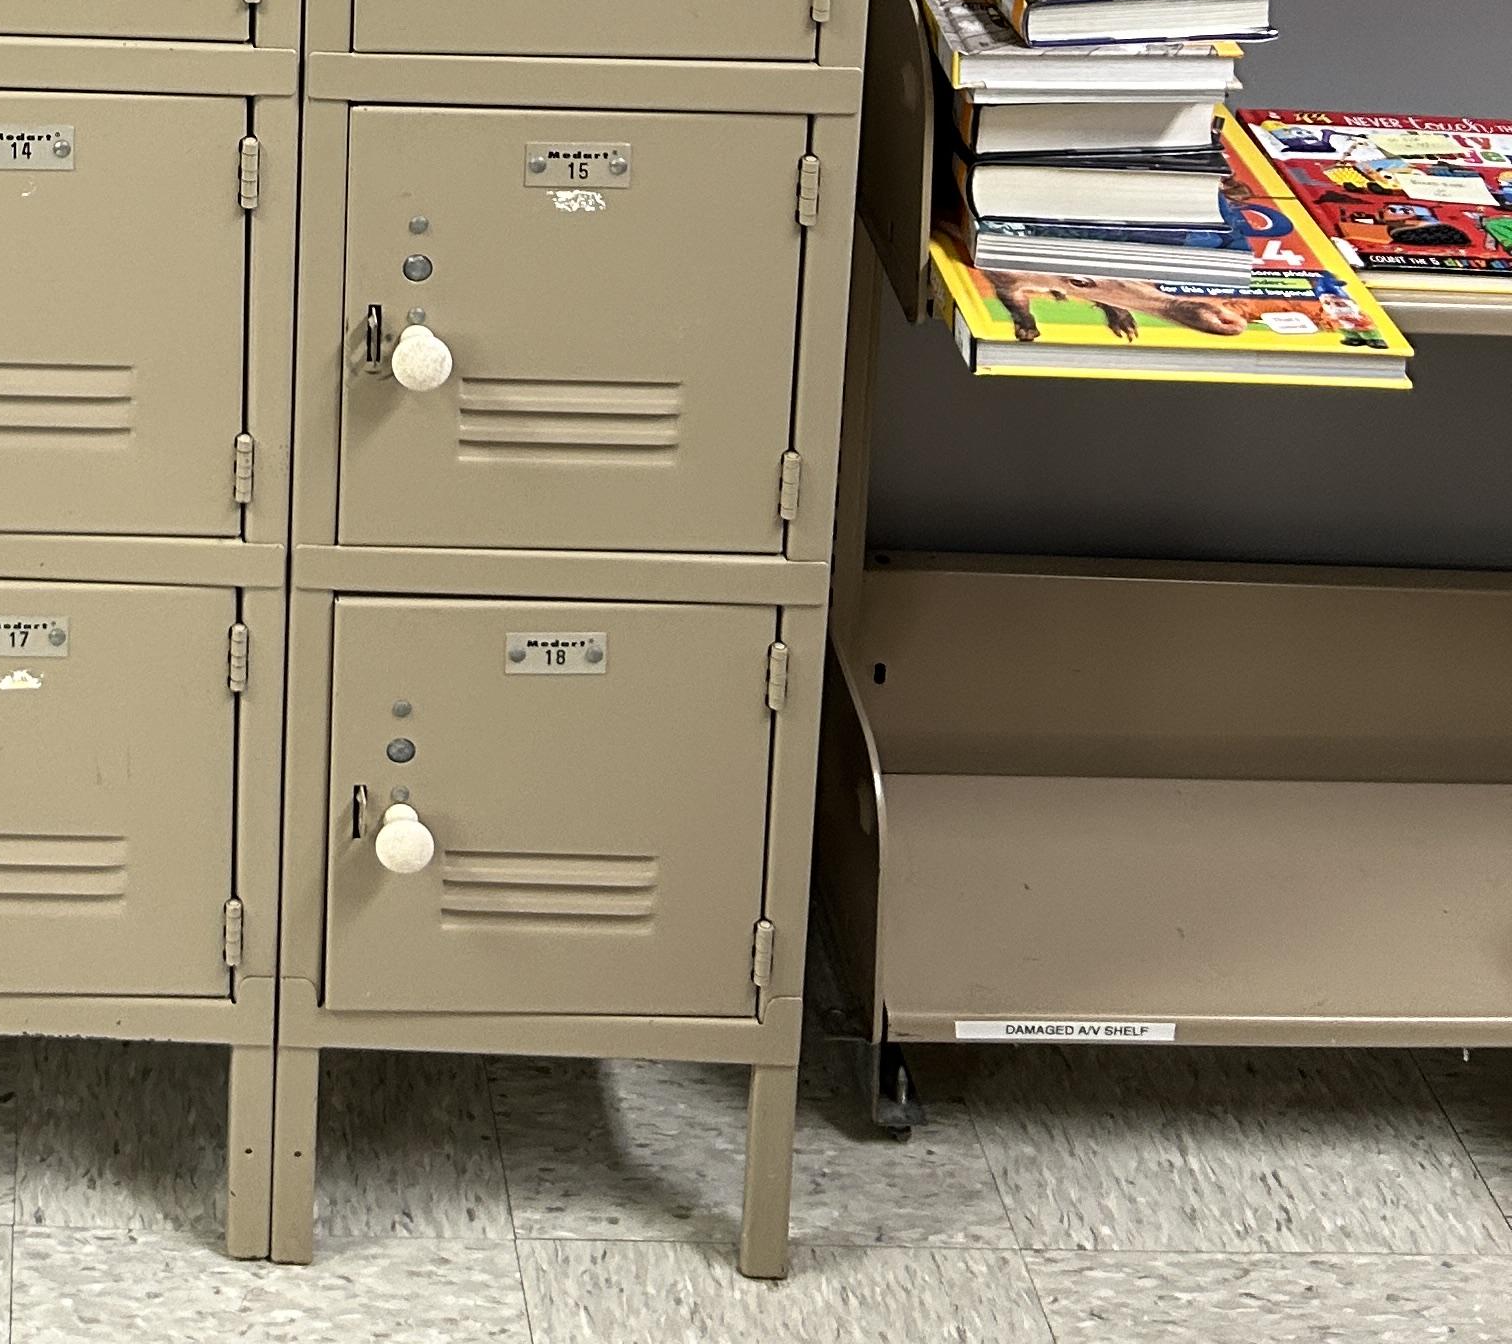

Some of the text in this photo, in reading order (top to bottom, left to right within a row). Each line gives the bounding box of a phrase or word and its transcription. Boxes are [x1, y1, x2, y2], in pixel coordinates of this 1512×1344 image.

[1343, 115, 1403, 128] NEVER
[1402, 116, 1487, 133] touch
[11, 142, 31, 159] 14
[569, 162, 588, 179] 15
[1369, 255, 1406, 264] COUNT
[1159, 285, 1178, 293] for
[1181, 286, 1204, 294] this
[1206, 287, 1235, 296] year
[10, 631, 28, 647] 17
[546, 650, 565, 665] 18
[1006, 1024, 1149, 1037] DAMAGED A/V SHELF
